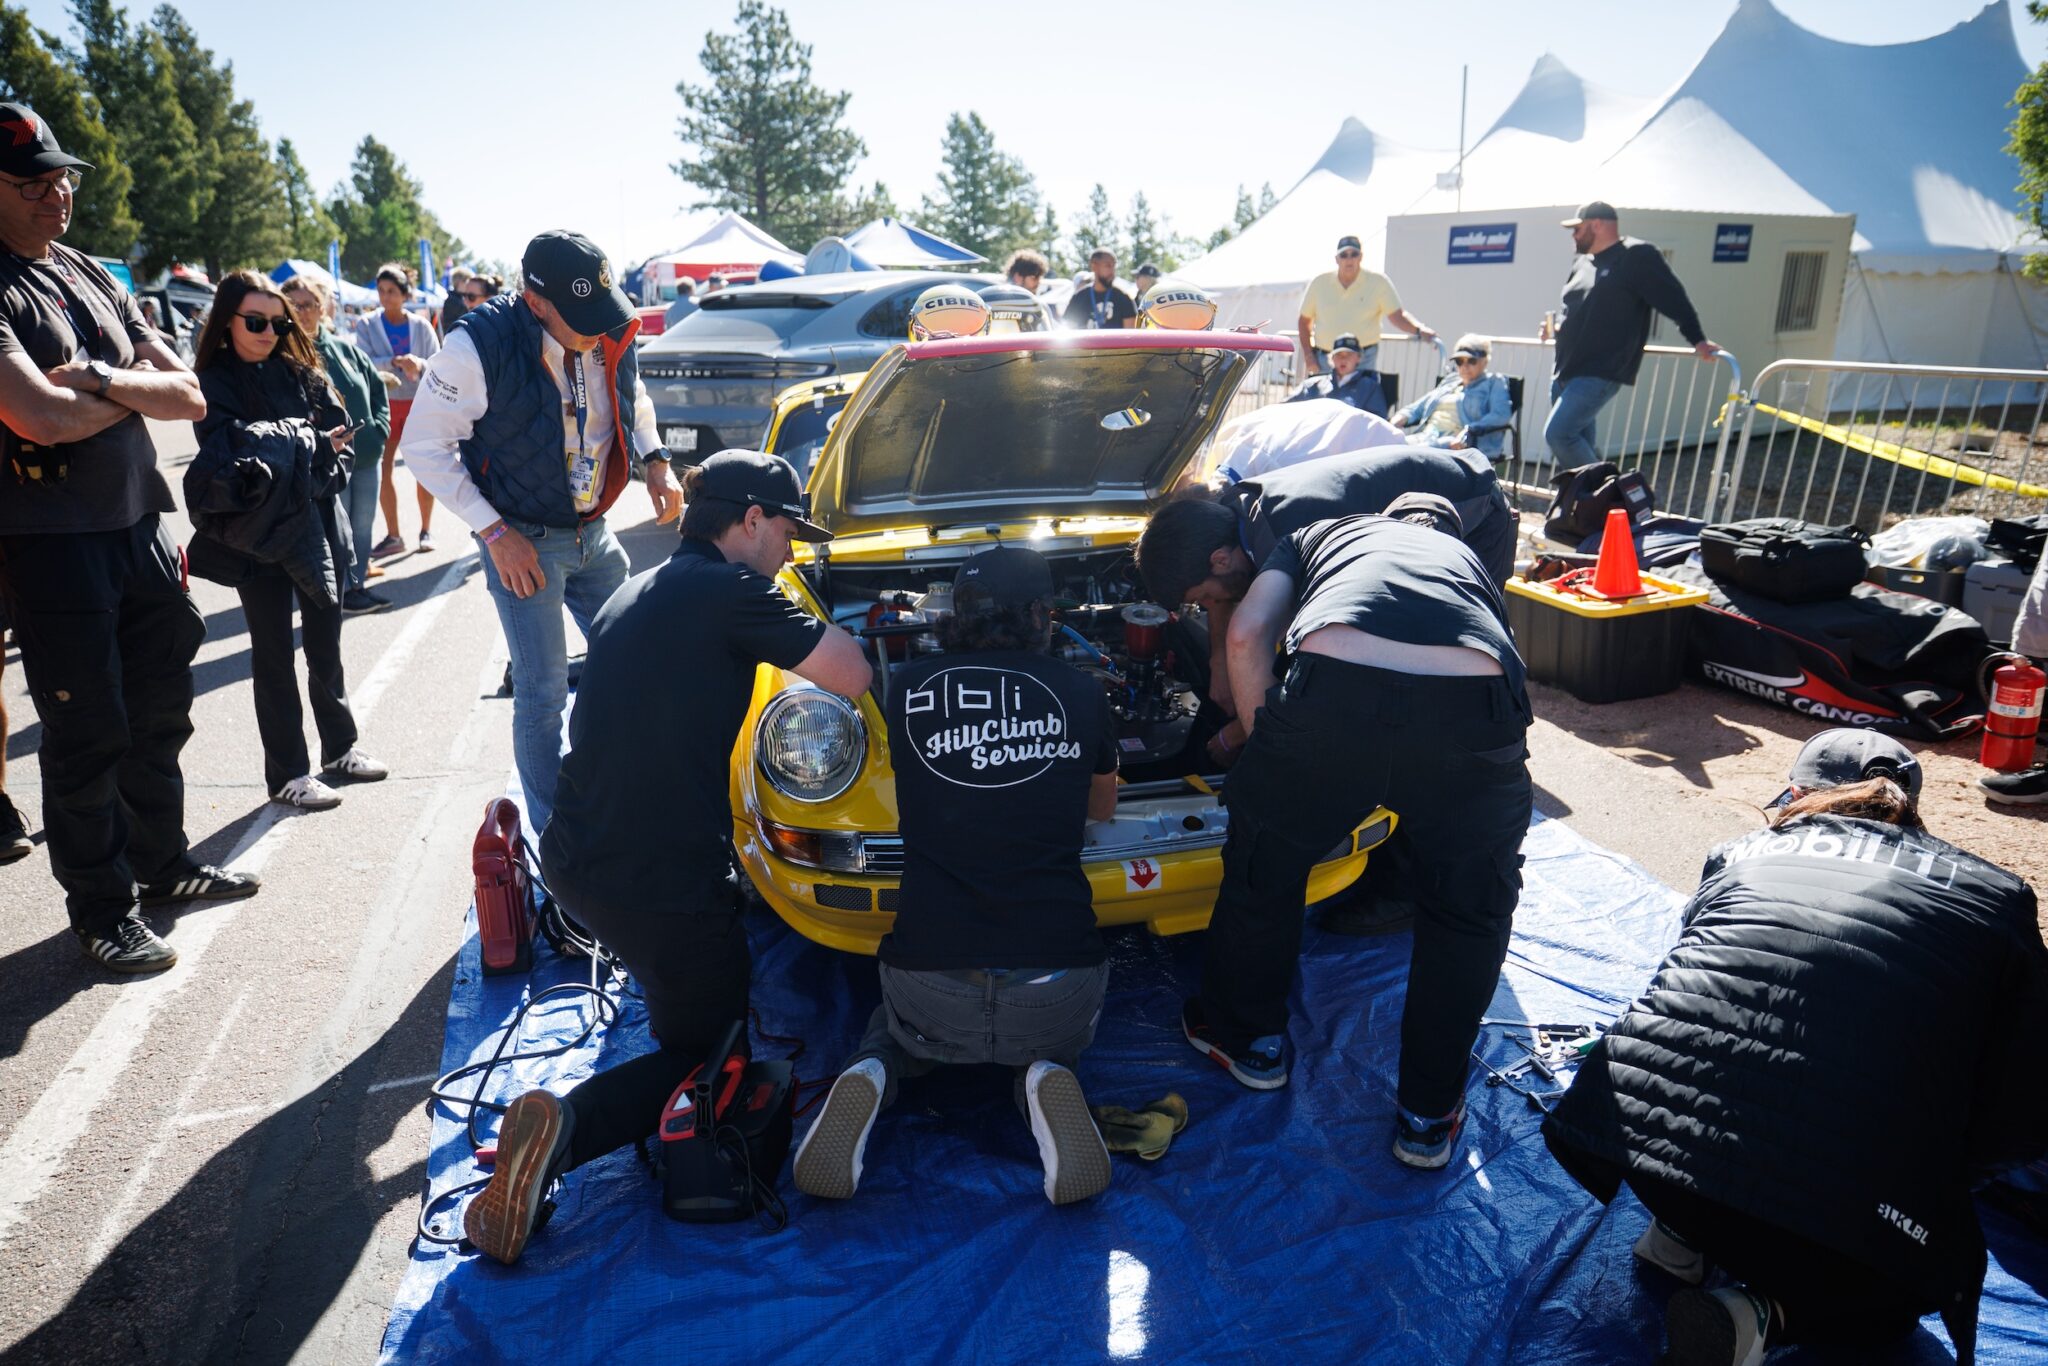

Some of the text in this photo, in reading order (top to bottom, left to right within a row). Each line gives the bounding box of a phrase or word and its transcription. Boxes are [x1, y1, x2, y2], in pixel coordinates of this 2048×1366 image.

[575, 283, 588, 294] 73
[993, 311, 1022, 320] VEITCH
[574, 357, 585, 383] TIRES
[652, 369, 711, 377] PORSCHE
[576, 384, 586, 409] TOYO
[1703, 663, 1788, 706] EXTREME
[926, 712, 1062, 759] HillClimb
[970, 737, 1081, 770] Services
[1724, 826, 1885, 869] Mobil
